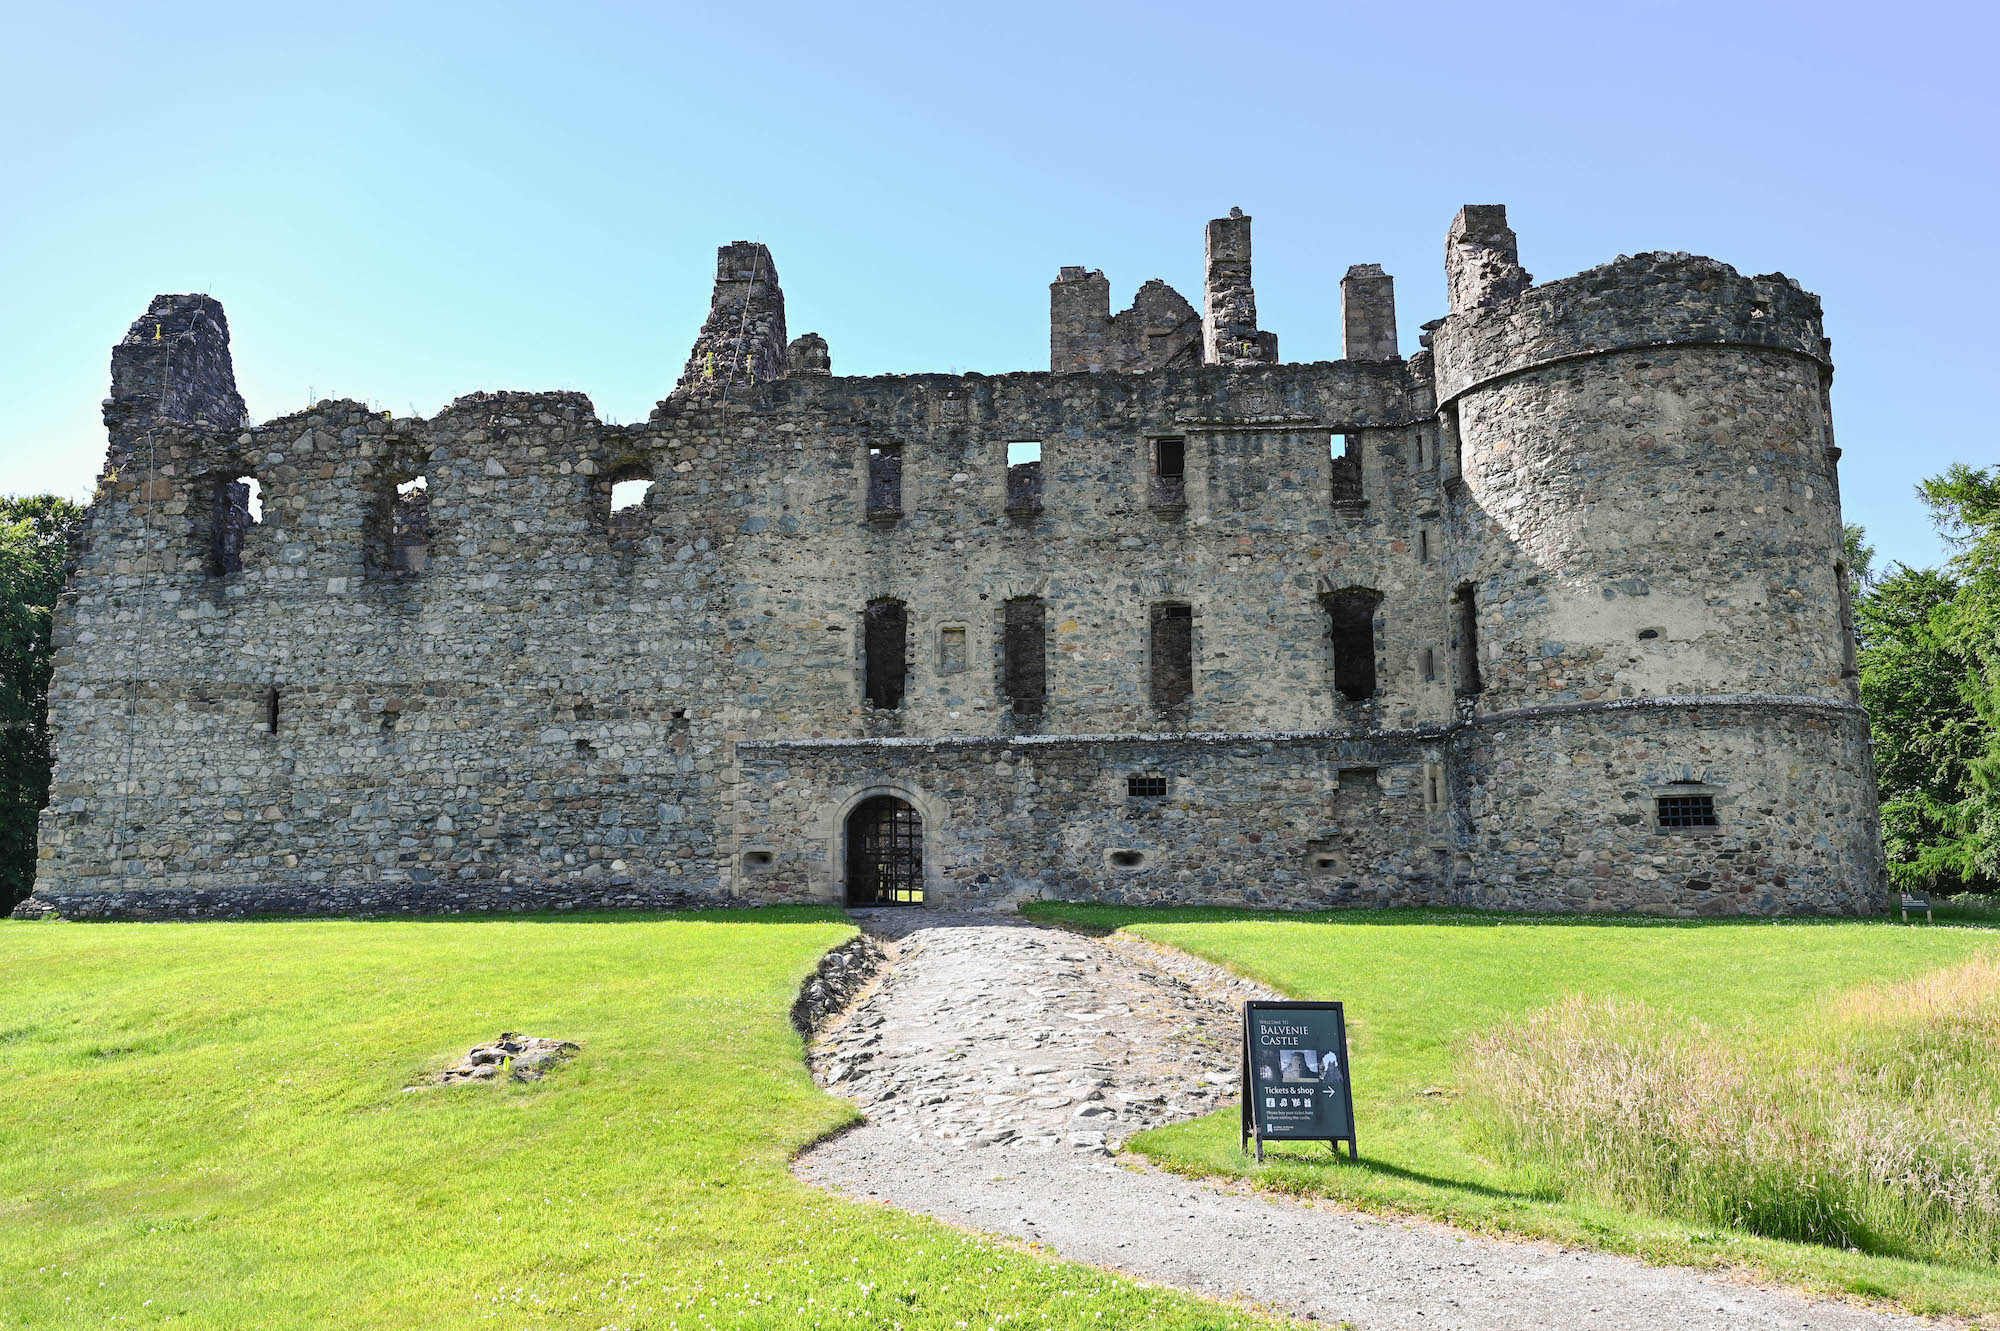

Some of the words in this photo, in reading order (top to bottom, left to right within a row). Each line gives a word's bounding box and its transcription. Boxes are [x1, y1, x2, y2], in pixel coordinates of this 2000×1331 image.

[1260, 1024, 1308, 1034] BALVENIE
[1260, 1035, 1298, 1045] CASTLE
[1297, 1086, 1314, 1096] shop
